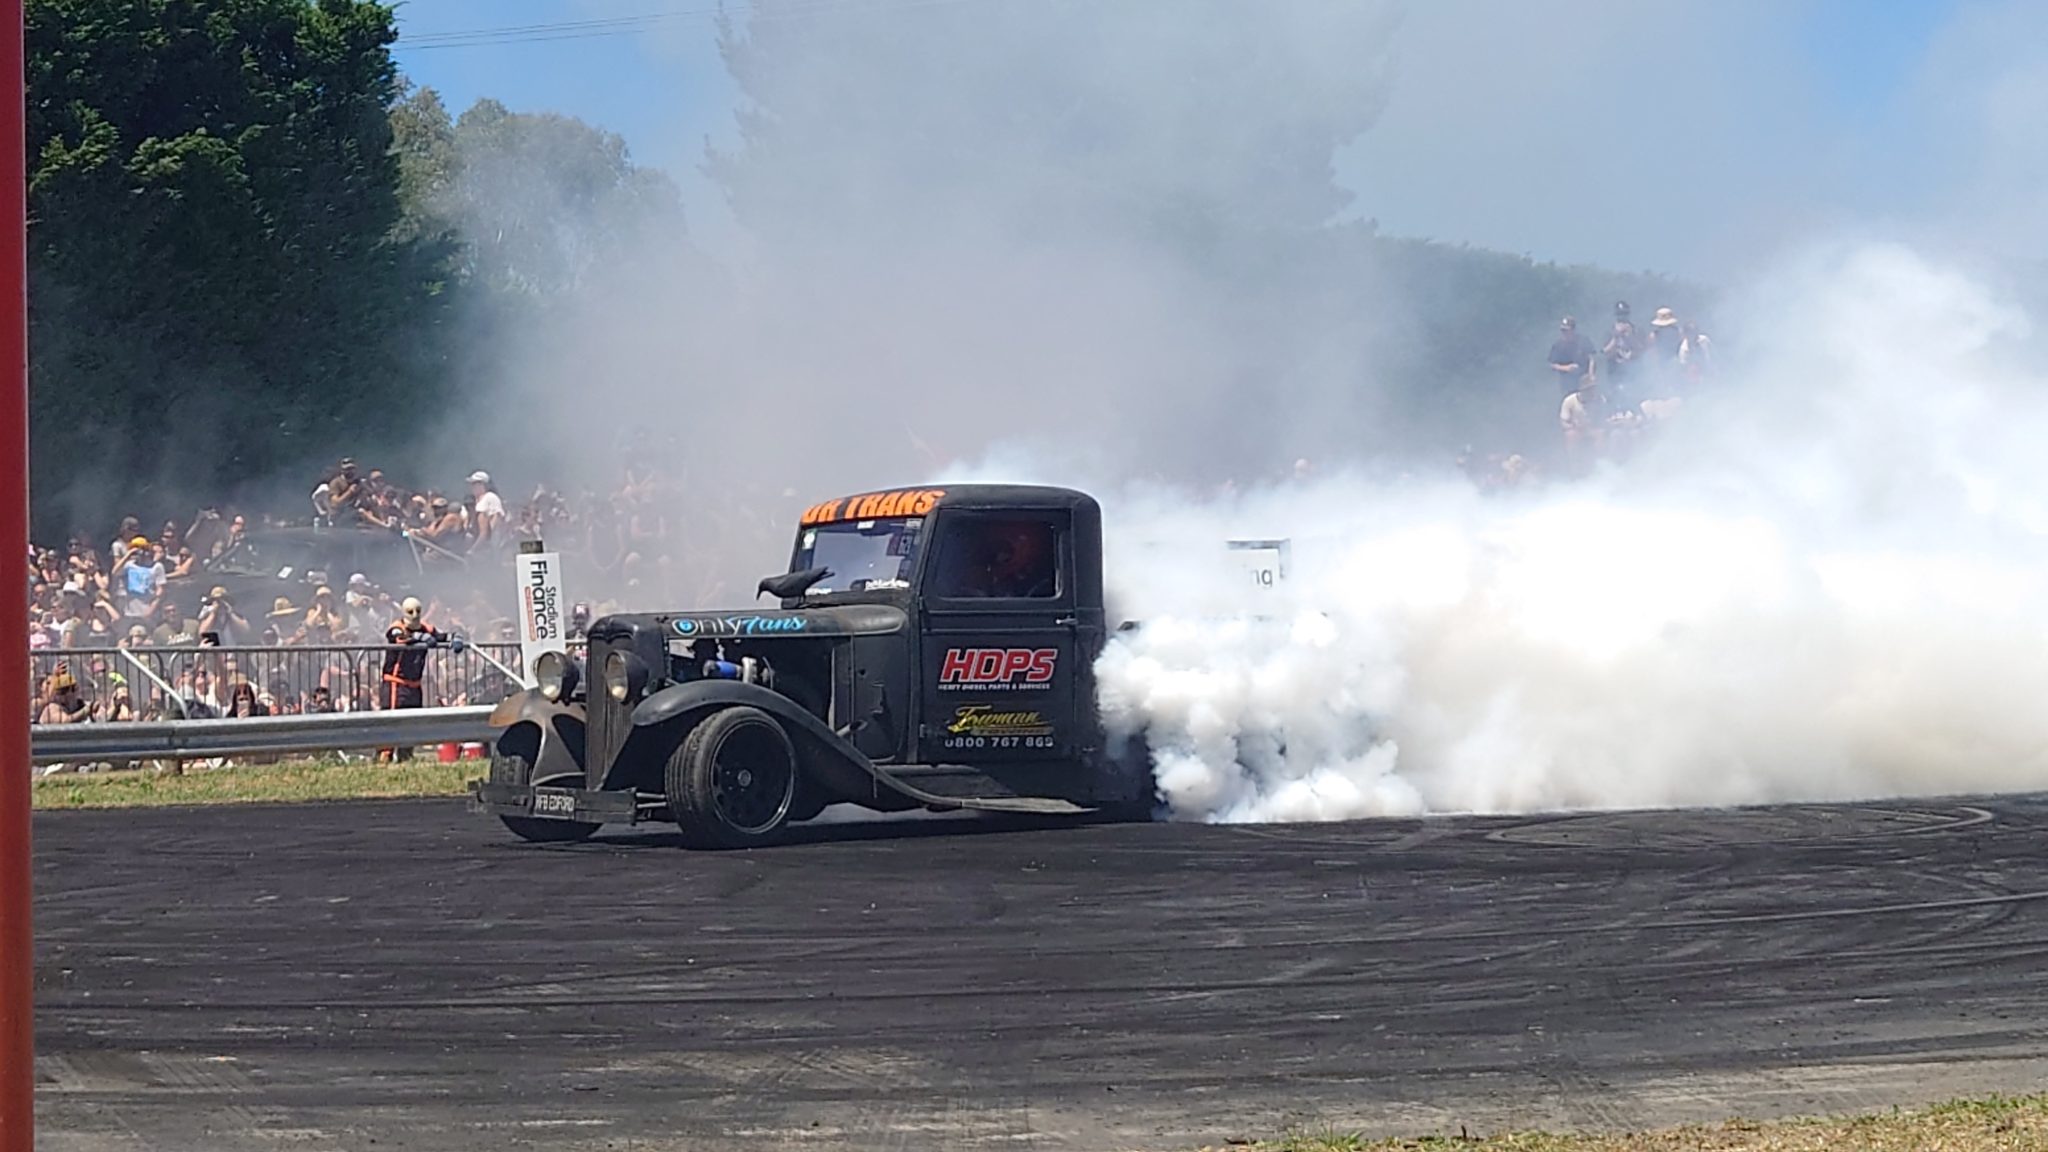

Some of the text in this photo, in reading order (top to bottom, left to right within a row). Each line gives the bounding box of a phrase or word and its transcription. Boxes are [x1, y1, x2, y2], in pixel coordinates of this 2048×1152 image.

[845, 490, 947, 519] TRANS
[530, 560, 549, 640] Finance
[545, 586, 558, 639] Stadium
[944, 737, 985, 748] 0800
[991, 737, 1020, 748] 767
